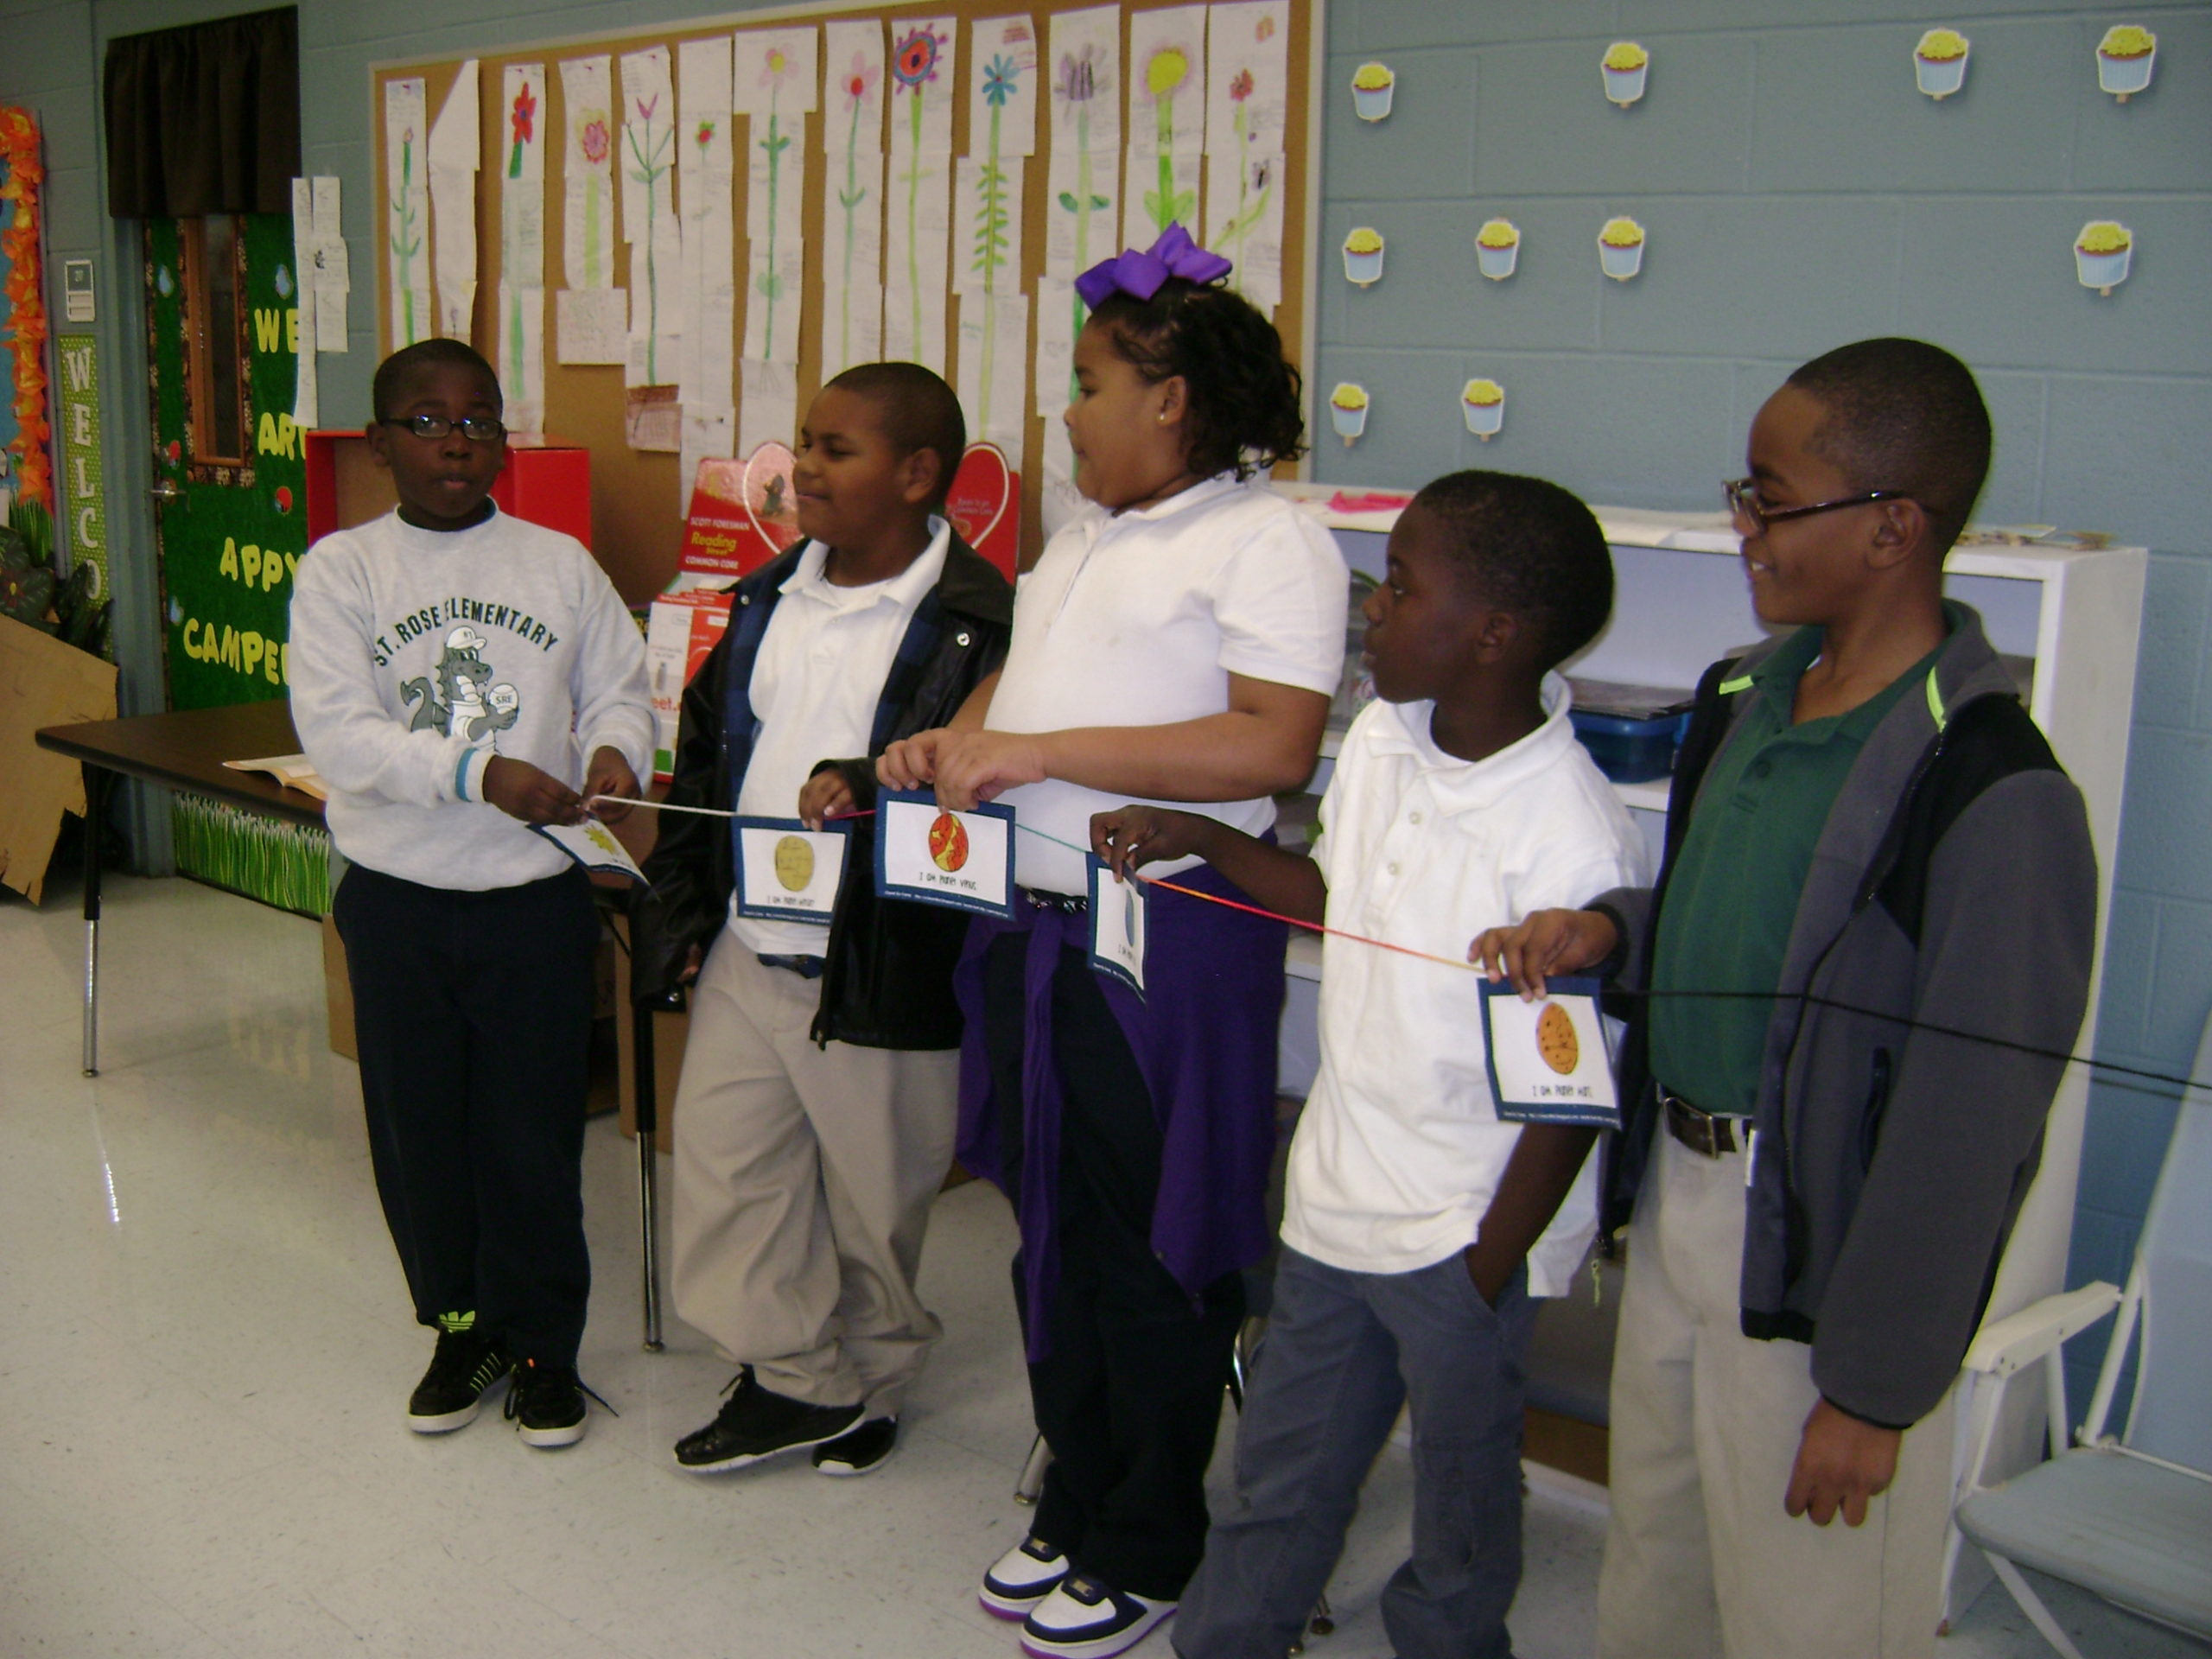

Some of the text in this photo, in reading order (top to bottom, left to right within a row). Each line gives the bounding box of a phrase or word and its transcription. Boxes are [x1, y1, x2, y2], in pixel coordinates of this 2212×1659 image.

[691, 531, 736, 551] Reading
[395, 606, 442, 645] ROSE
[495, 694, 513, 704] SRE
